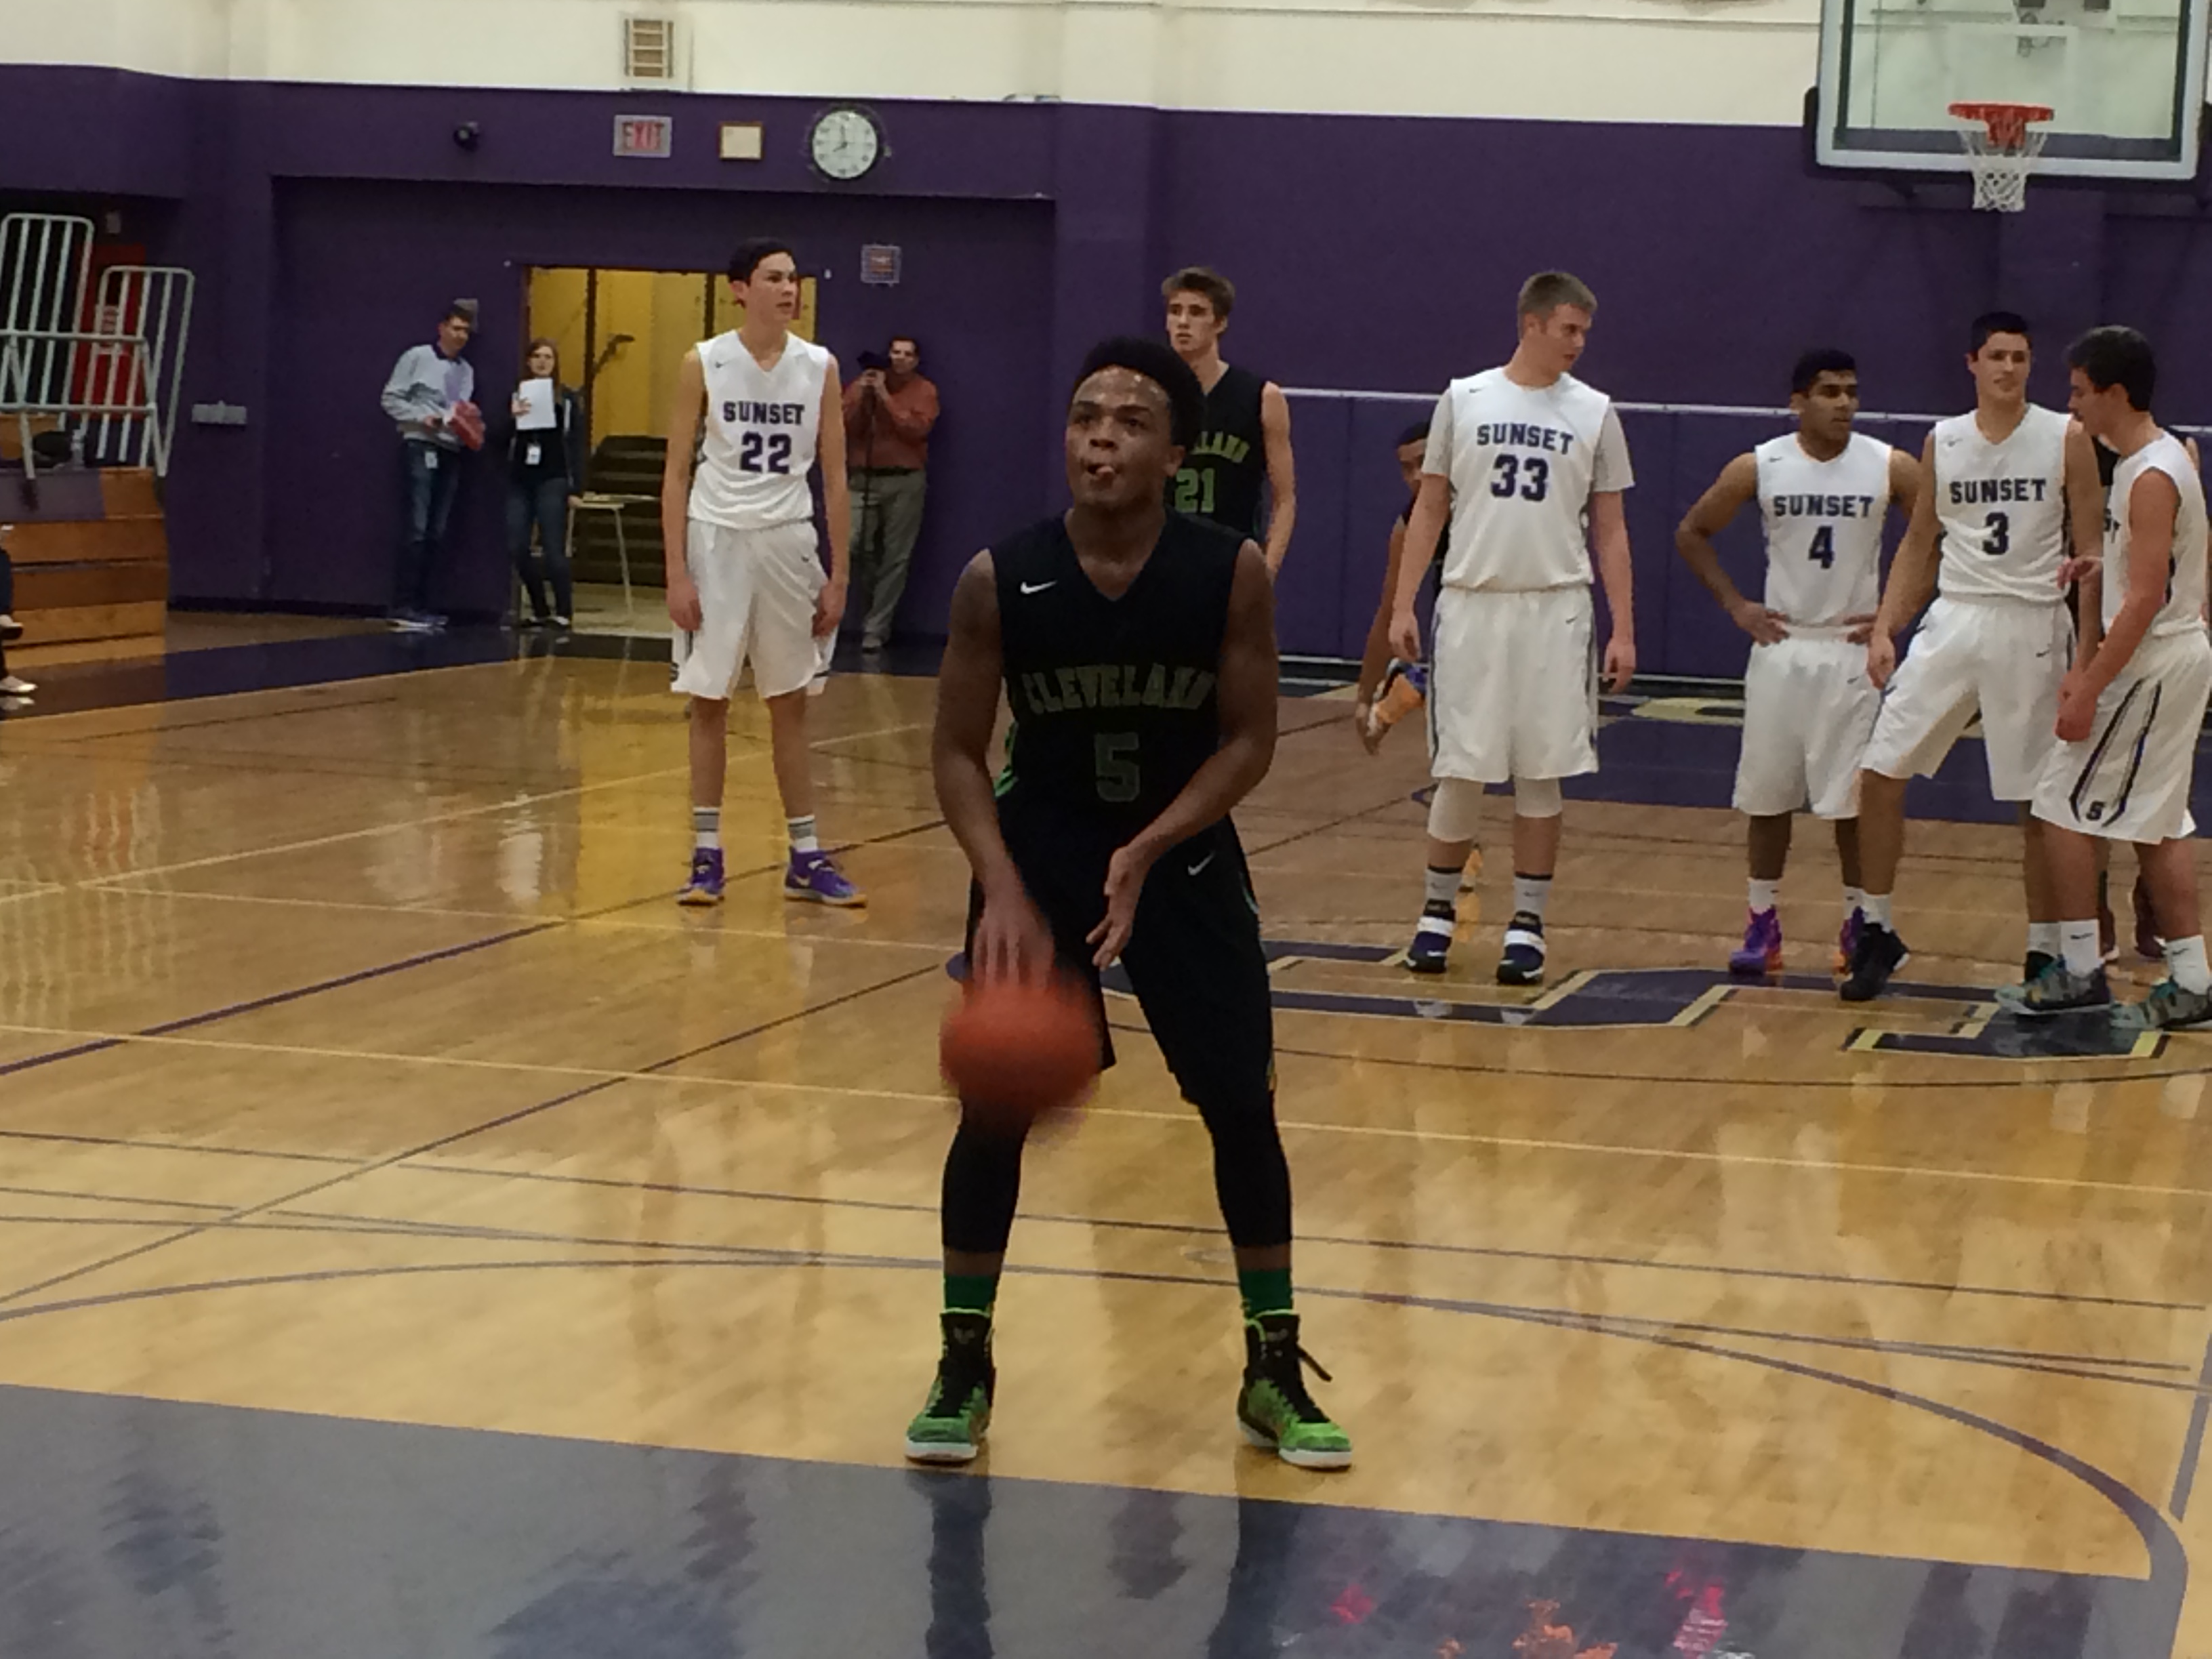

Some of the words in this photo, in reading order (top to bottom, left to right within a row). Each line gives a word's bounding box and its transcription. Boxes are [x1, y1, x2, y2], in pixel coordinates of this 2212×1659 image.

[622, 121, 665, 150] EXIT
[723, 401, 805, 425] SUNSET
[740, 430, 792, 474] 22
[1477, 423, 1574, 455] SUNSET
[1174, 468, 1214, 513] 21
[1491, 453, 1549, 501] 33
[1949, 477, 2046, 504] SUNSET
[1773, 495, 1874, 517] SUNSET
[1808, 525, 1835, 569] 4
[1983, 512, 2009, 555] 3
[1093, 732, 1141, 802] 5
[2086, 800, 2106, 821] S
